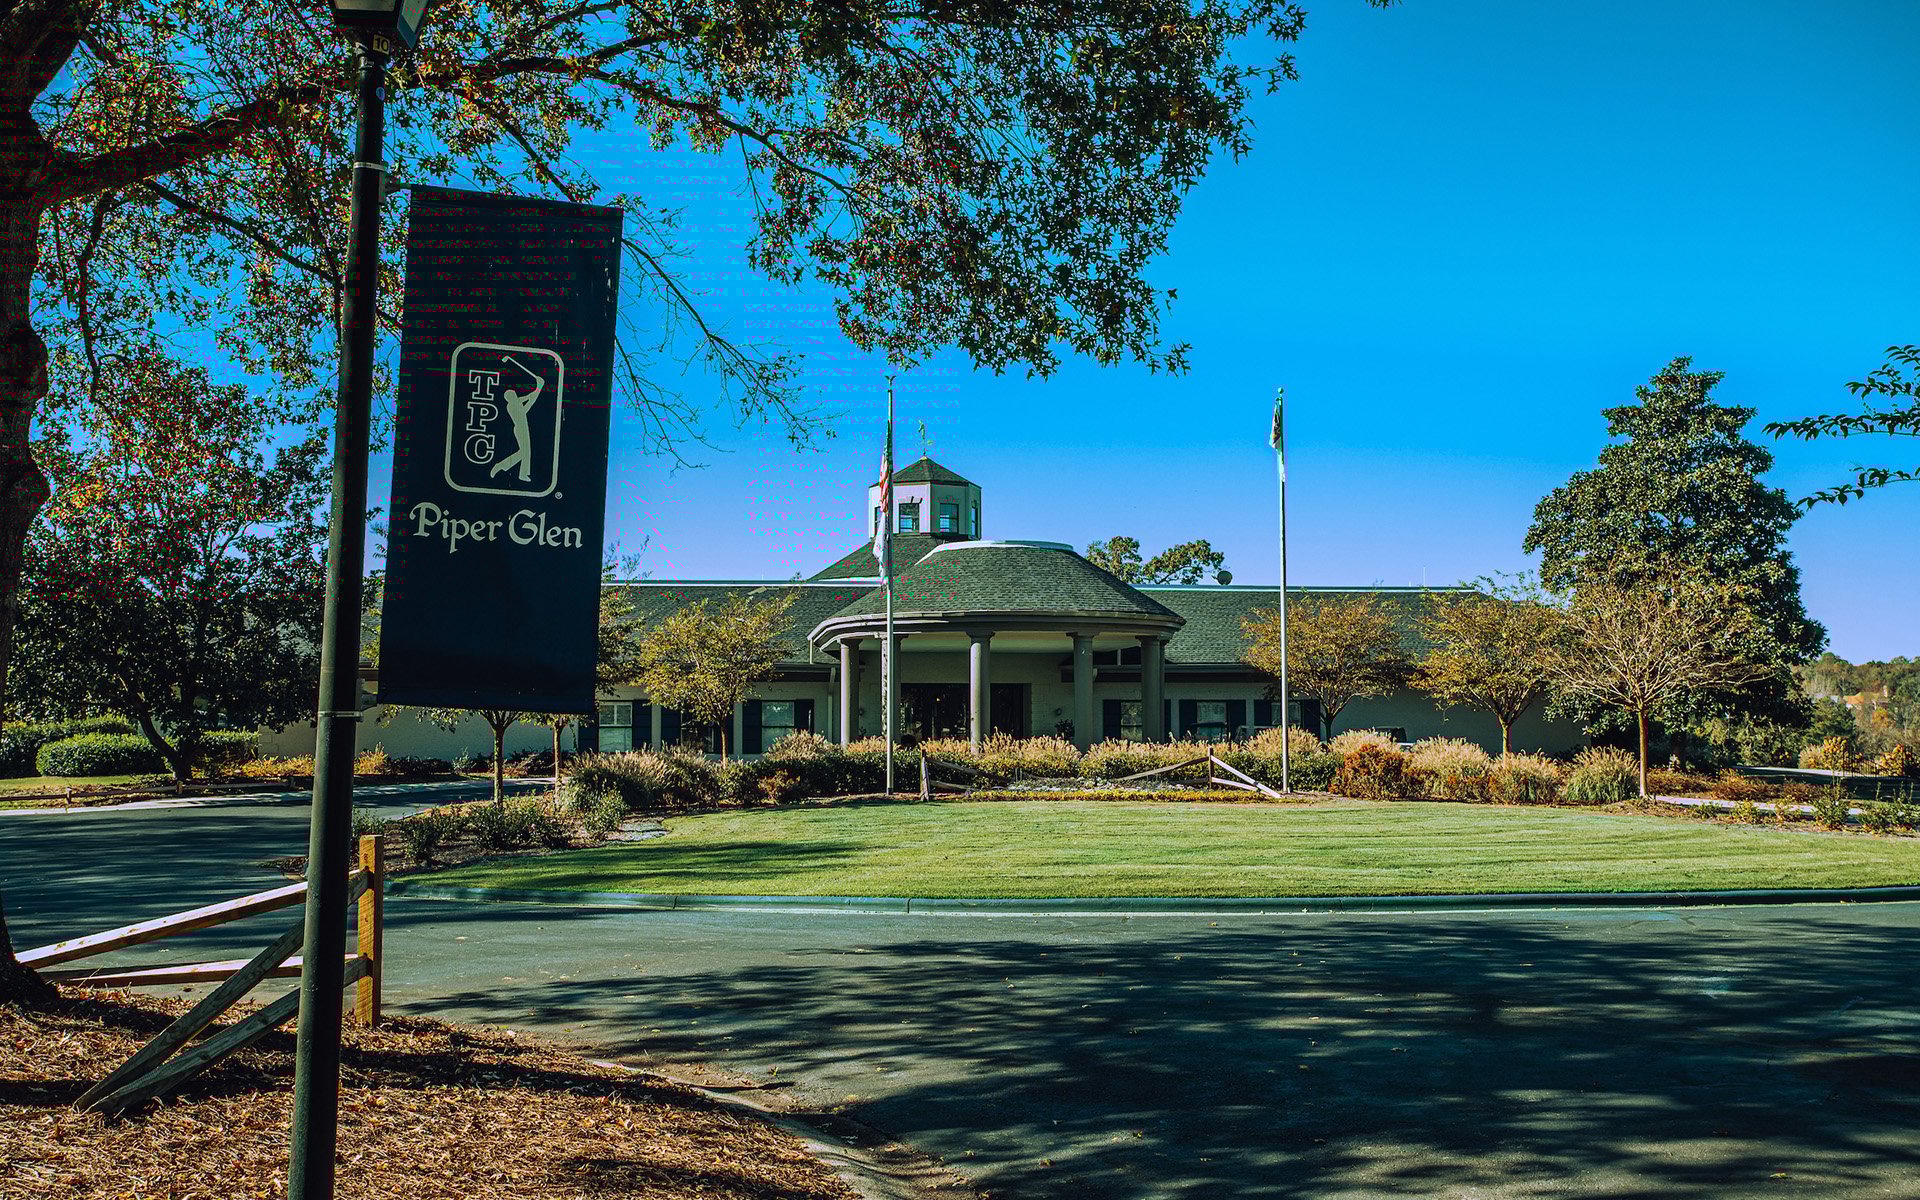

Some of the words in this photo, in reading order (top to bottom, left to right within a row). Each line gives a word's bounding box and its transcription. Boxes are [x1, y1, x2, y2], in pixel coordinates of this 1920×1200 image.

[375, 37, 389, 51] 10
[464, 370, 499, 464] TPC
[409, 502, 503, 554] Piper
[508, 509, 583, 549] Glen
